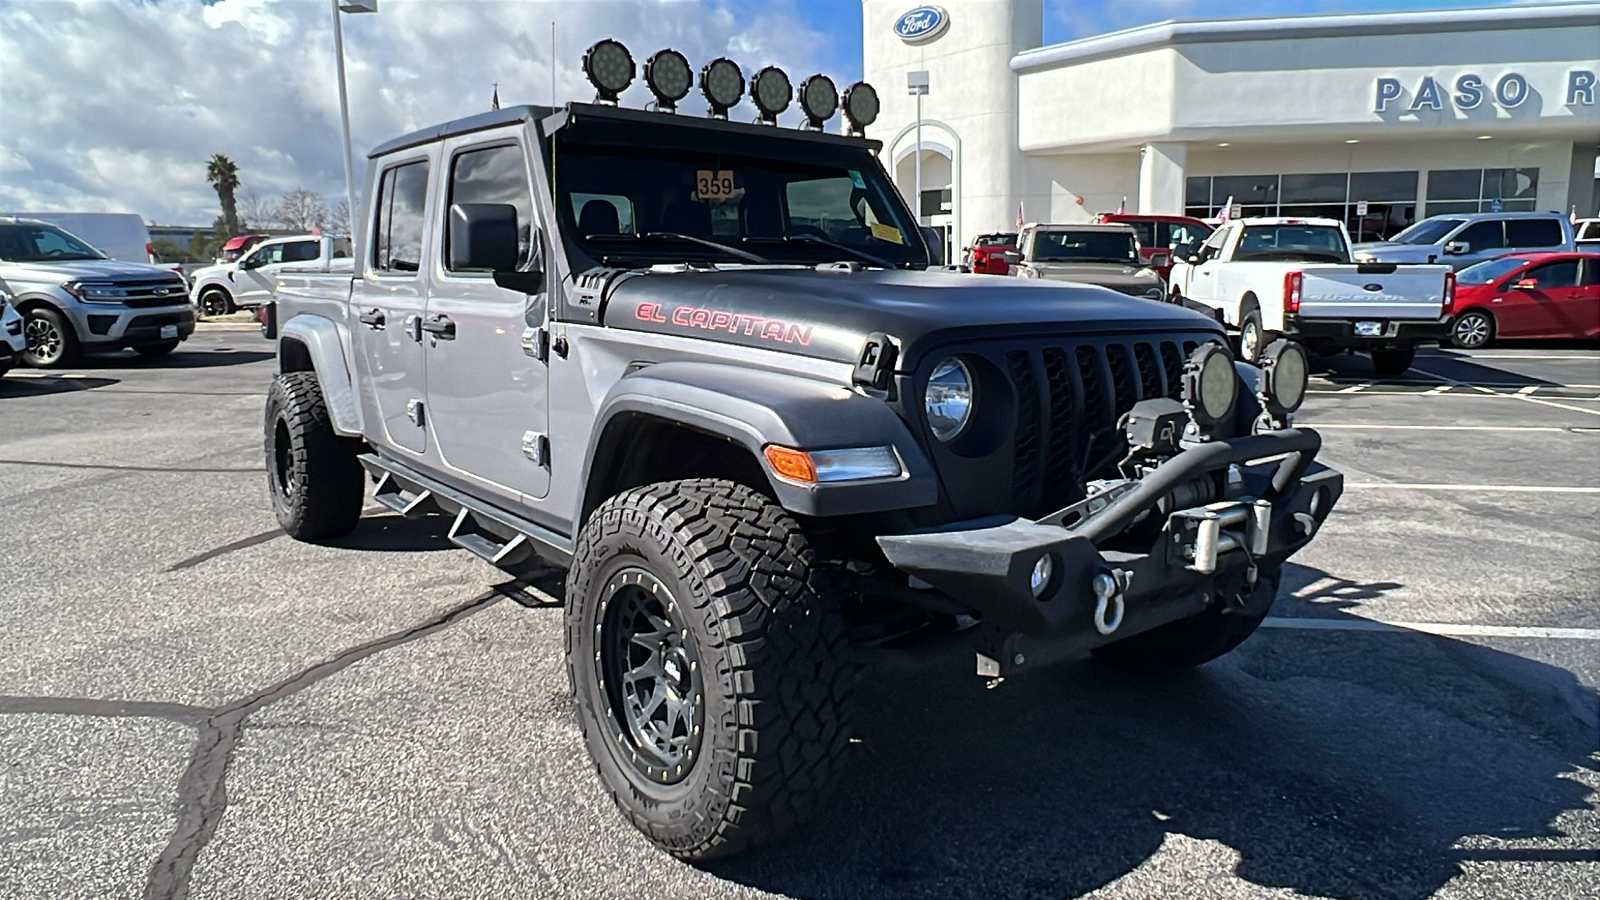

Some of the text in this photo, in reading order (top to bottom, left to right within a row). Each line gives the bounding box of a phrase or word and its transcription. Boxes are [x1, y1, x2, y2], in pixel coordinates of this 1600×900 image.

[902, 12, 931, 33] Ford
[1375, 72, 1529, 111] PASO
[699, 178, 732, 195] 359
[636, 303, 813, 345] EL CAPITAN
